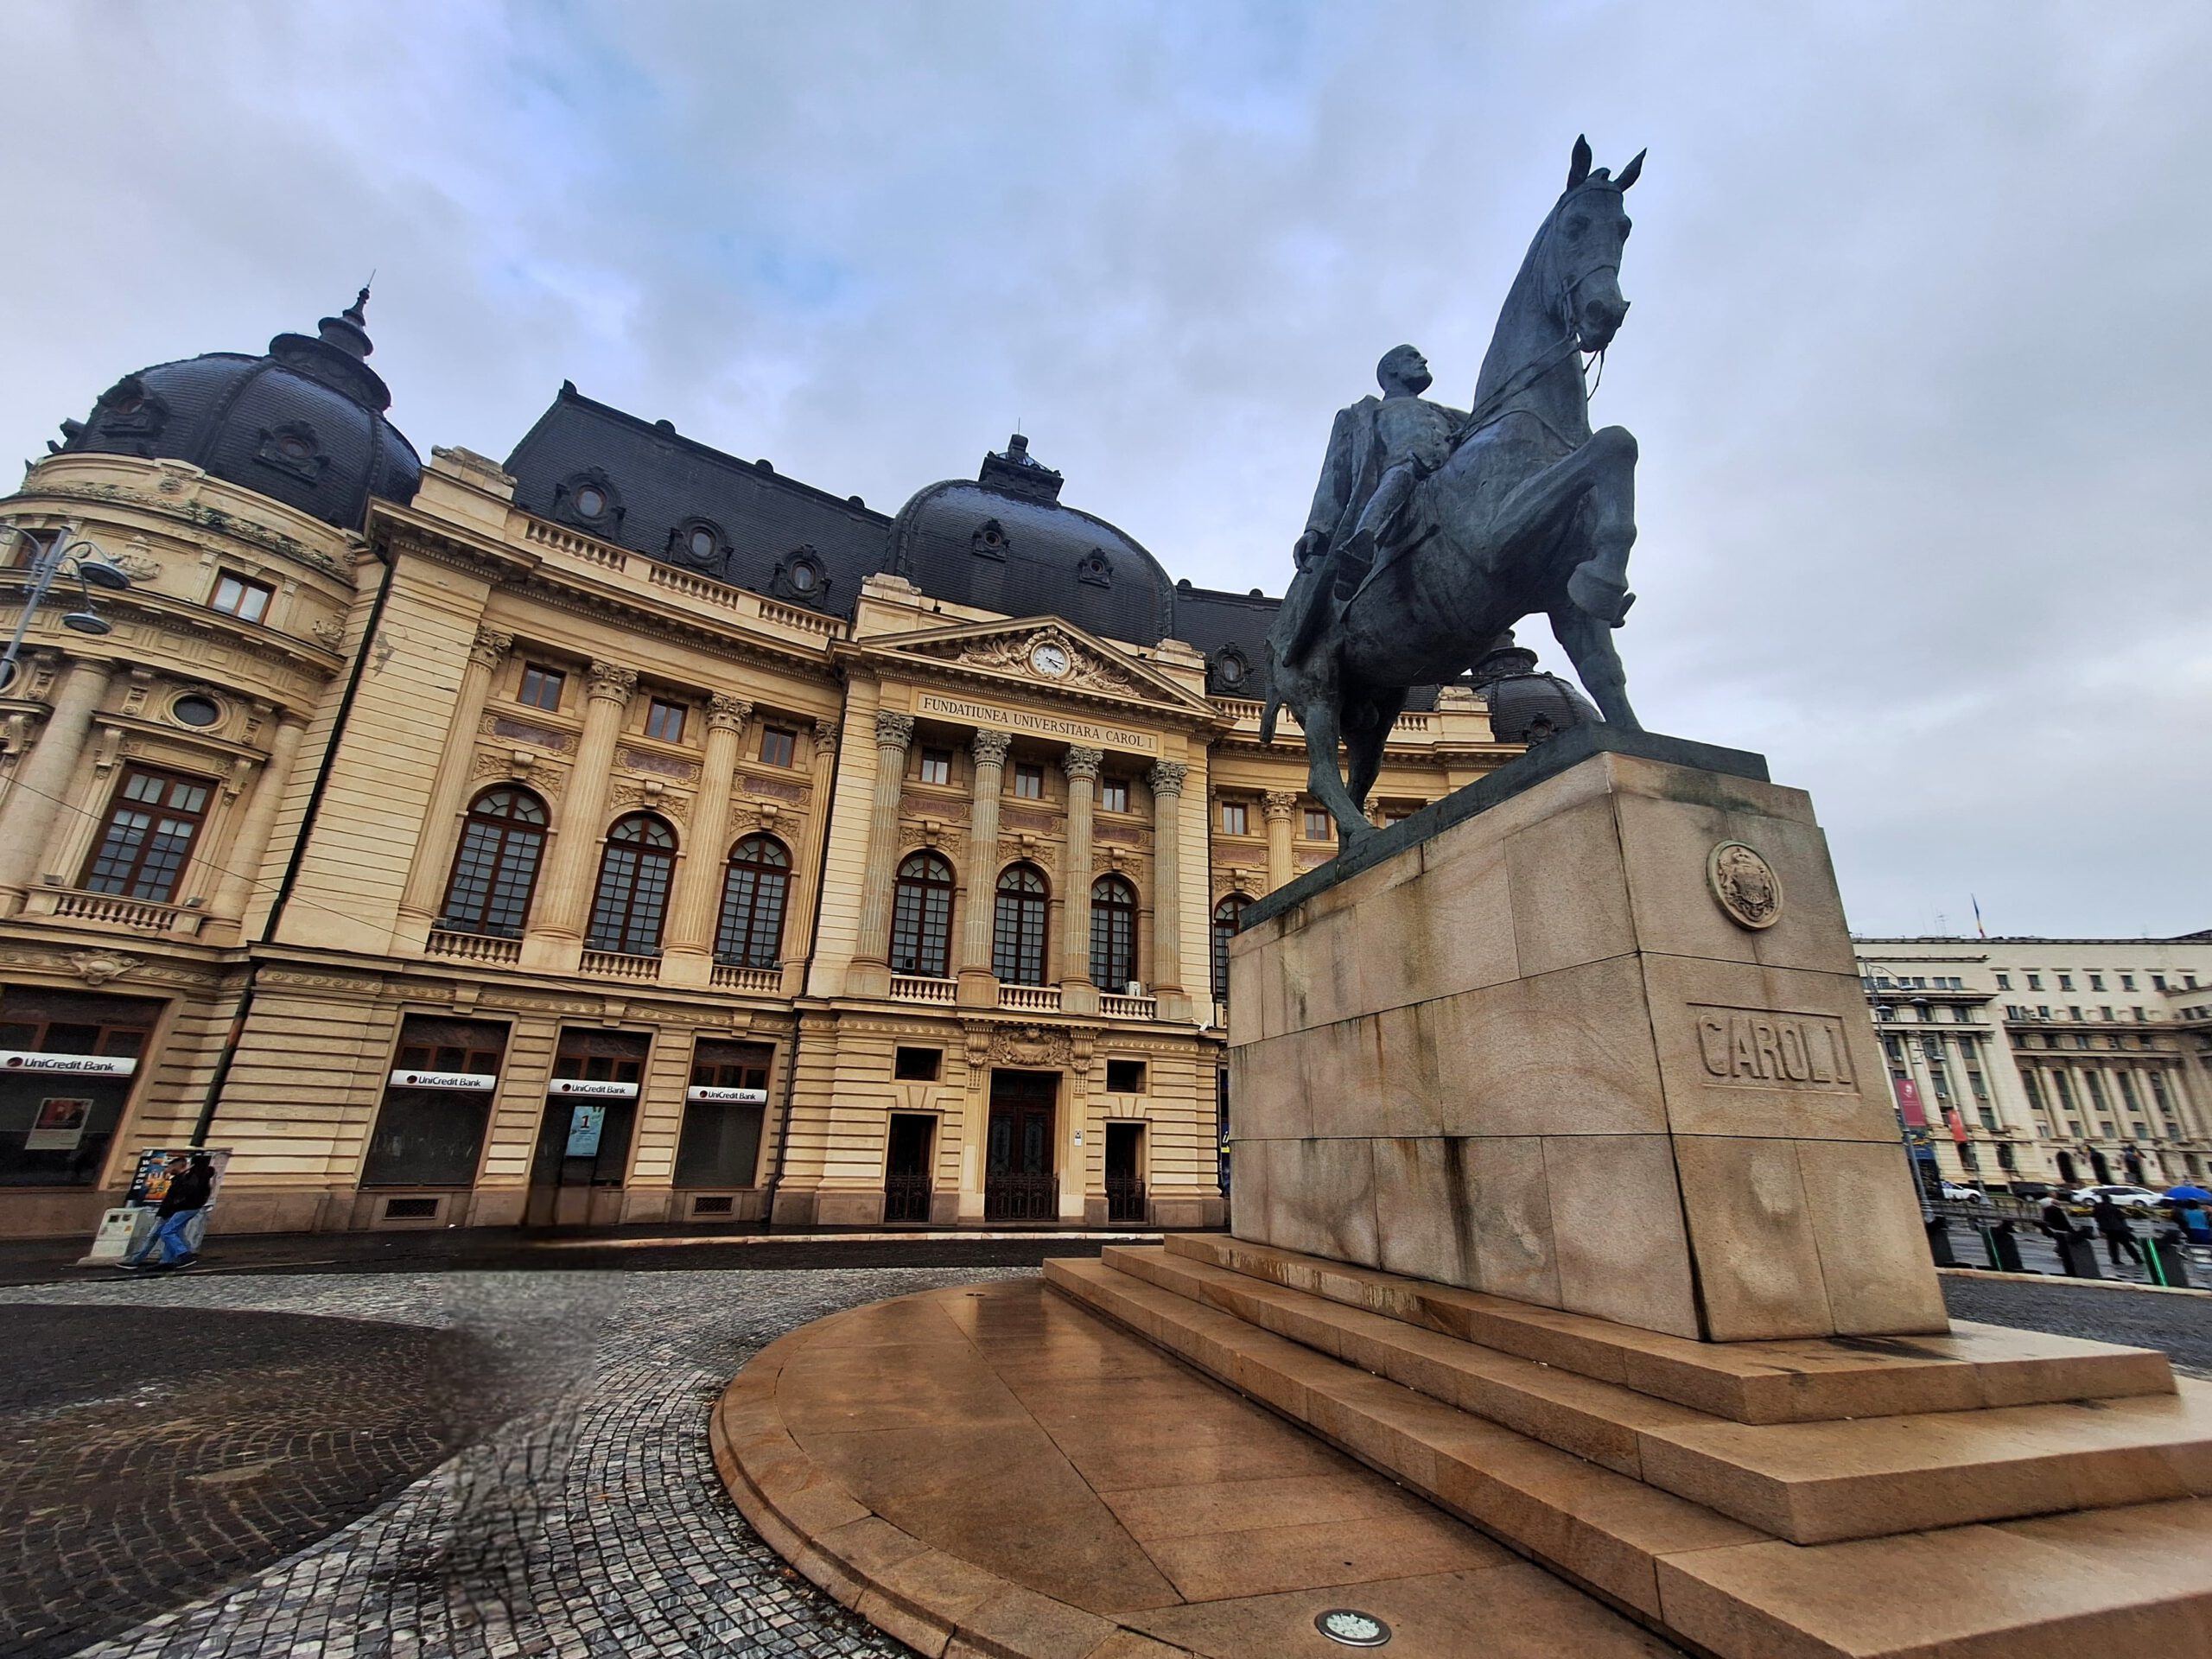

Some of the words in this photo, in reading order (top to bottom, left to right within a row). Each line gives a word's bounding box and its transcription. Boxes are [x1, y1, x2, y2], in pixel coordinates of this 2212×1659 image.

[924, 697, 1008, 723] FUNDATIUNEA
[1014, 714, 1100, 739] UNIVERSITARA
[1105, 730, 1143, 747] CAROL
[1697, 1014, 1831, 1084] CAROL
[1824, 1025, 1852, 1085] I
[24, 1058, 81, 1071] UniCredit
[83, 1060, 115, 1071] Bank
[418, 1076, 458, 1086] UniCredit
[459, 1077, 481, 1087] Bank
[571, 1084, 606, 1094] UniCredit
[607, 1085, 626, 1094] Bank
[709, 1090, 738, 1099] UniCredit
[739, 1091, 756, 1100] Bank
